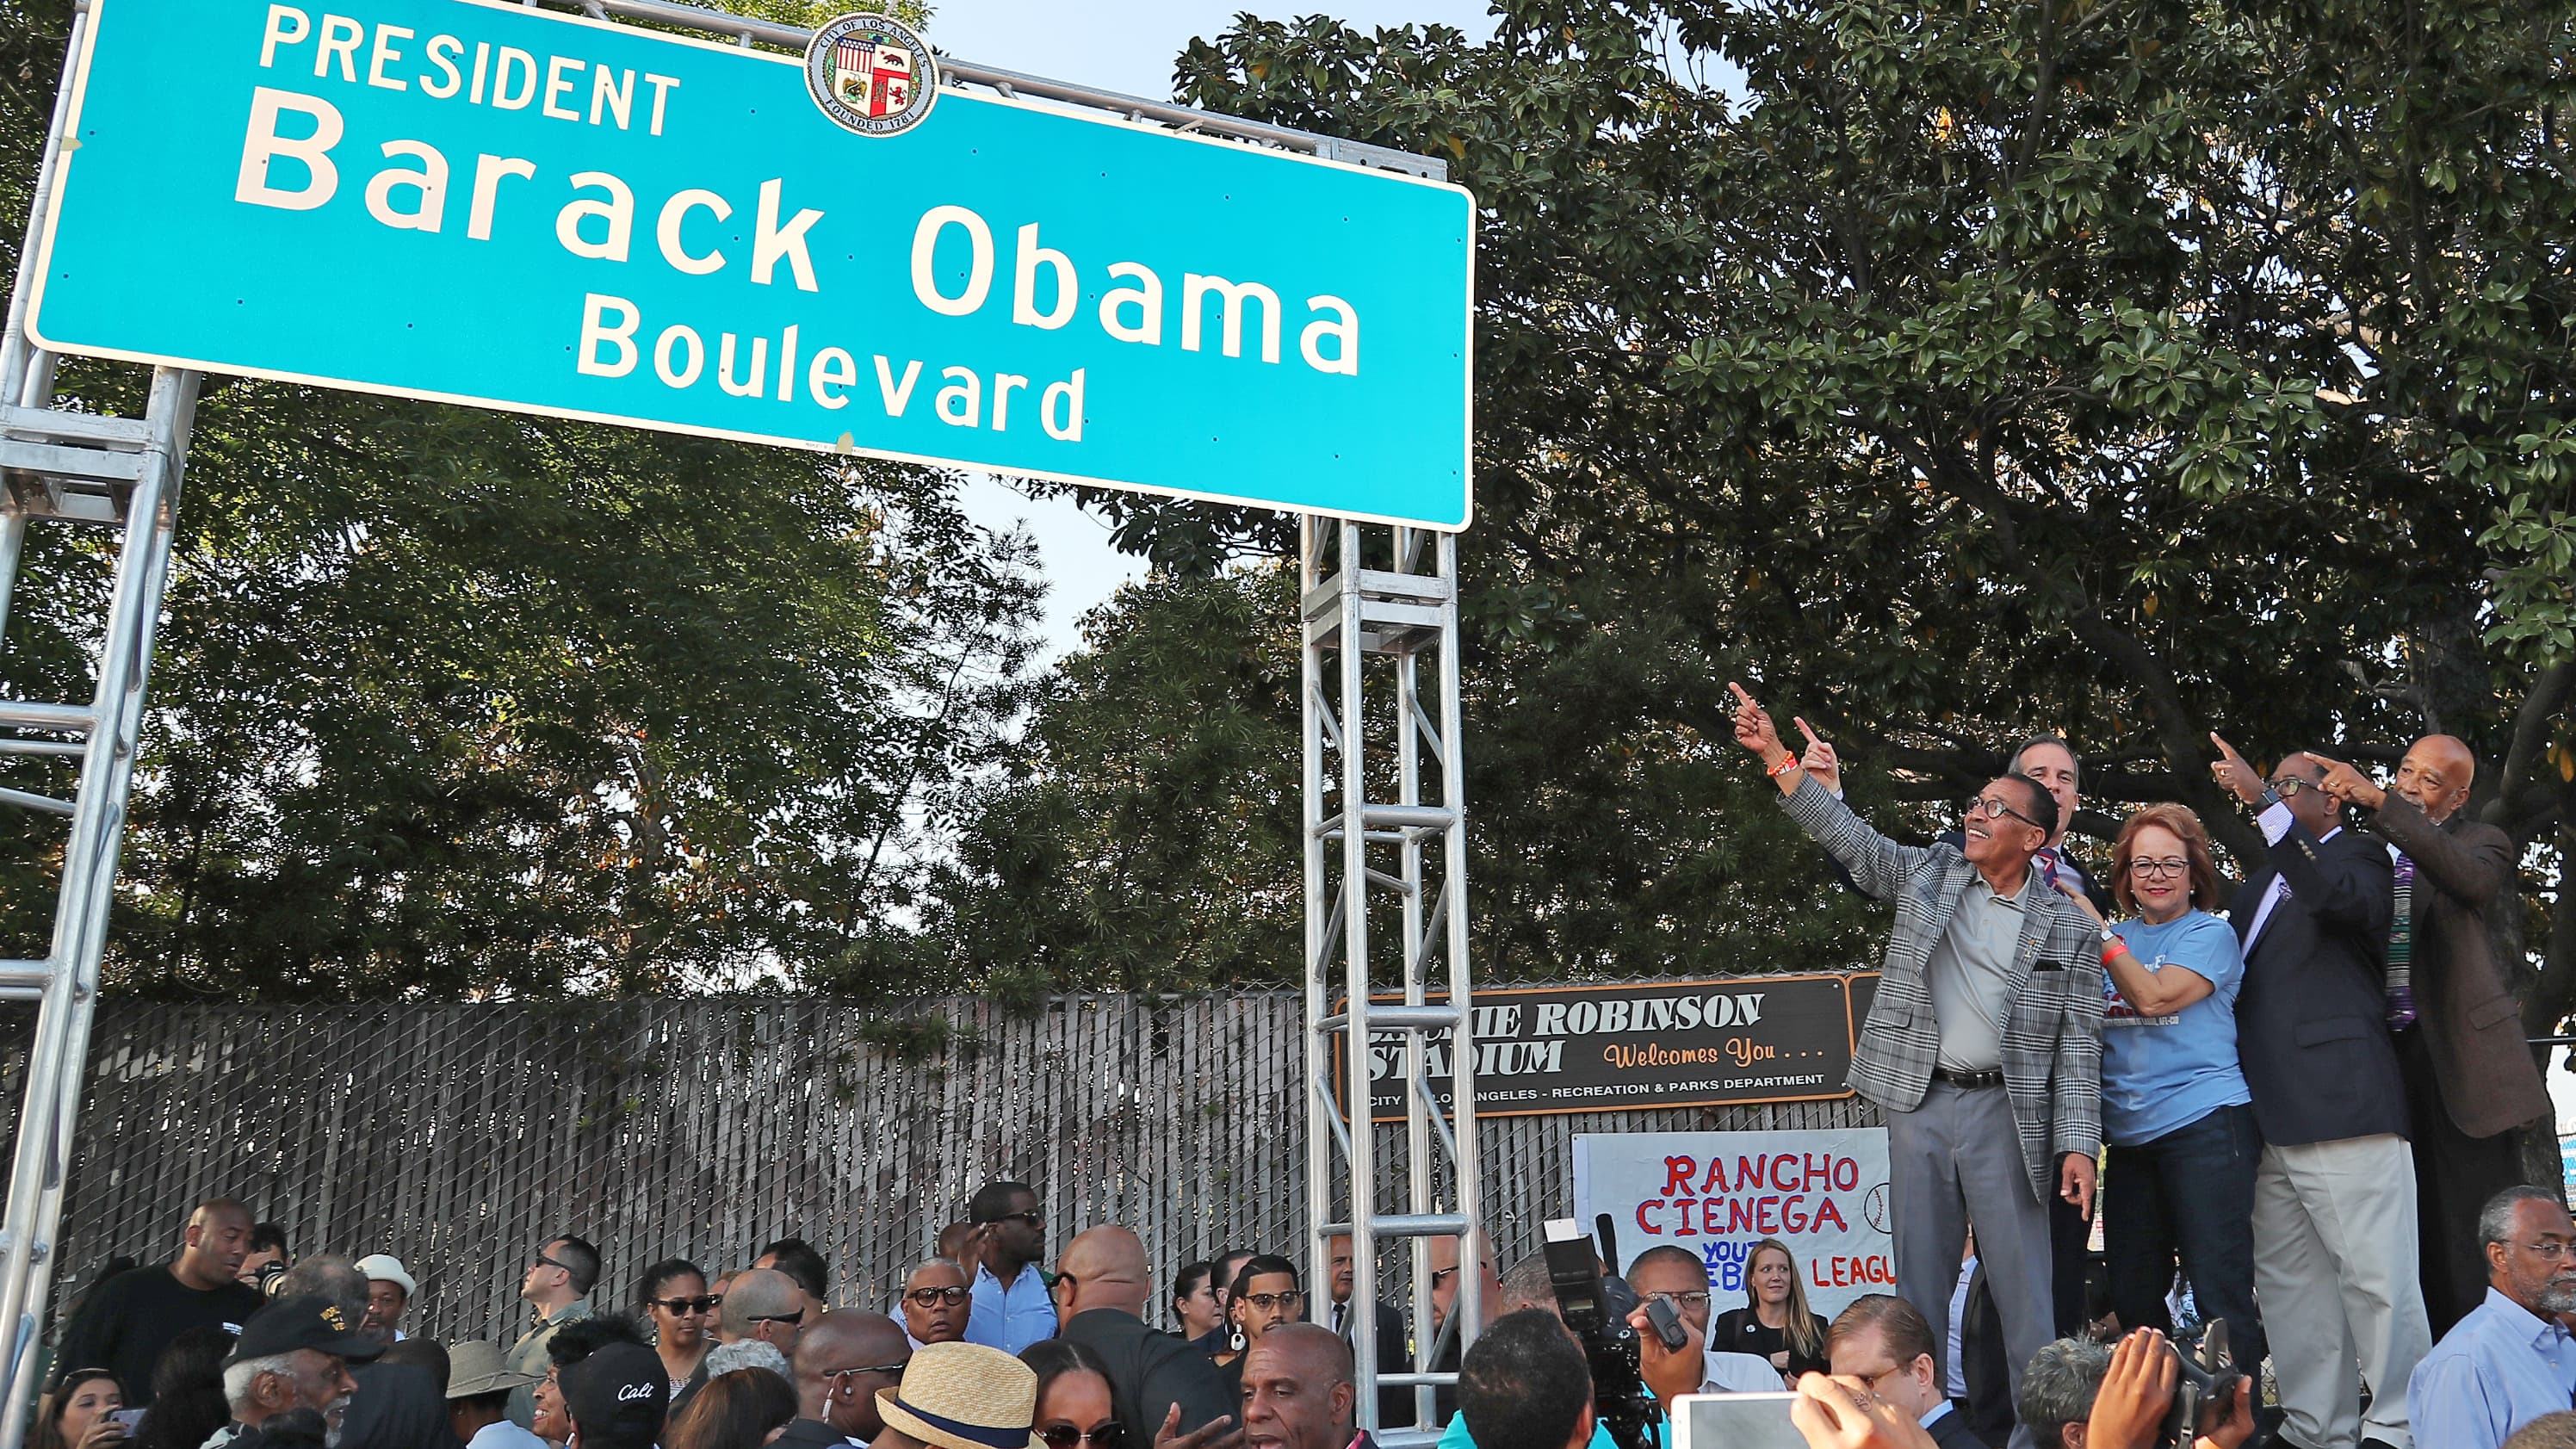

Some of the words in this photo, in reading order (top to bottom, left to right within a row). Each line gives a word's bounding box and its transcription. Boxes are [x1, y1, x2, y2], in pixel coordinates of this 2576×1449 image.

[820, 28, 839, 48] CITY
[843, 21, 858, 32] OF
[863, 20, 886, 30] LOS
[889, 27, 929, 68] ANGELES
[259, 4, 681, 137] PRESIDENT
[826, 99, 883, 130] FOUNDED
[890, 112, 915, 128] 1781
[234, 85, 826, 293] Barack
[910, 204, 1359, 377] Obama
[576, 292, 1086, 443] Boulevard
[1533, 993, 1765, 1037] ROBINSON
[1603, 1043, 1718, 1068] Welcomes
[1725, 1037, 1776, 1068] You
[1370, 1095, 1402, 1106] CITY
[1474, 1089, 1538, 1102] NGELES
[1551, 1083, 1650, 1099] RECREATION
[1654, 1083, 1665, 1093] &
[1669, 1080, 1719, 1092] PARKS
[1724, 1074, 1824, 1089] DEPARTMENT
[1660, 1153, 1860, 1198] RANCHO
[1636, 1195, 1848, 1237] CIENEGA
[1811, 1255, 1897, 1287] LEAGU
[617, 1382, 654, 1402] Cali
